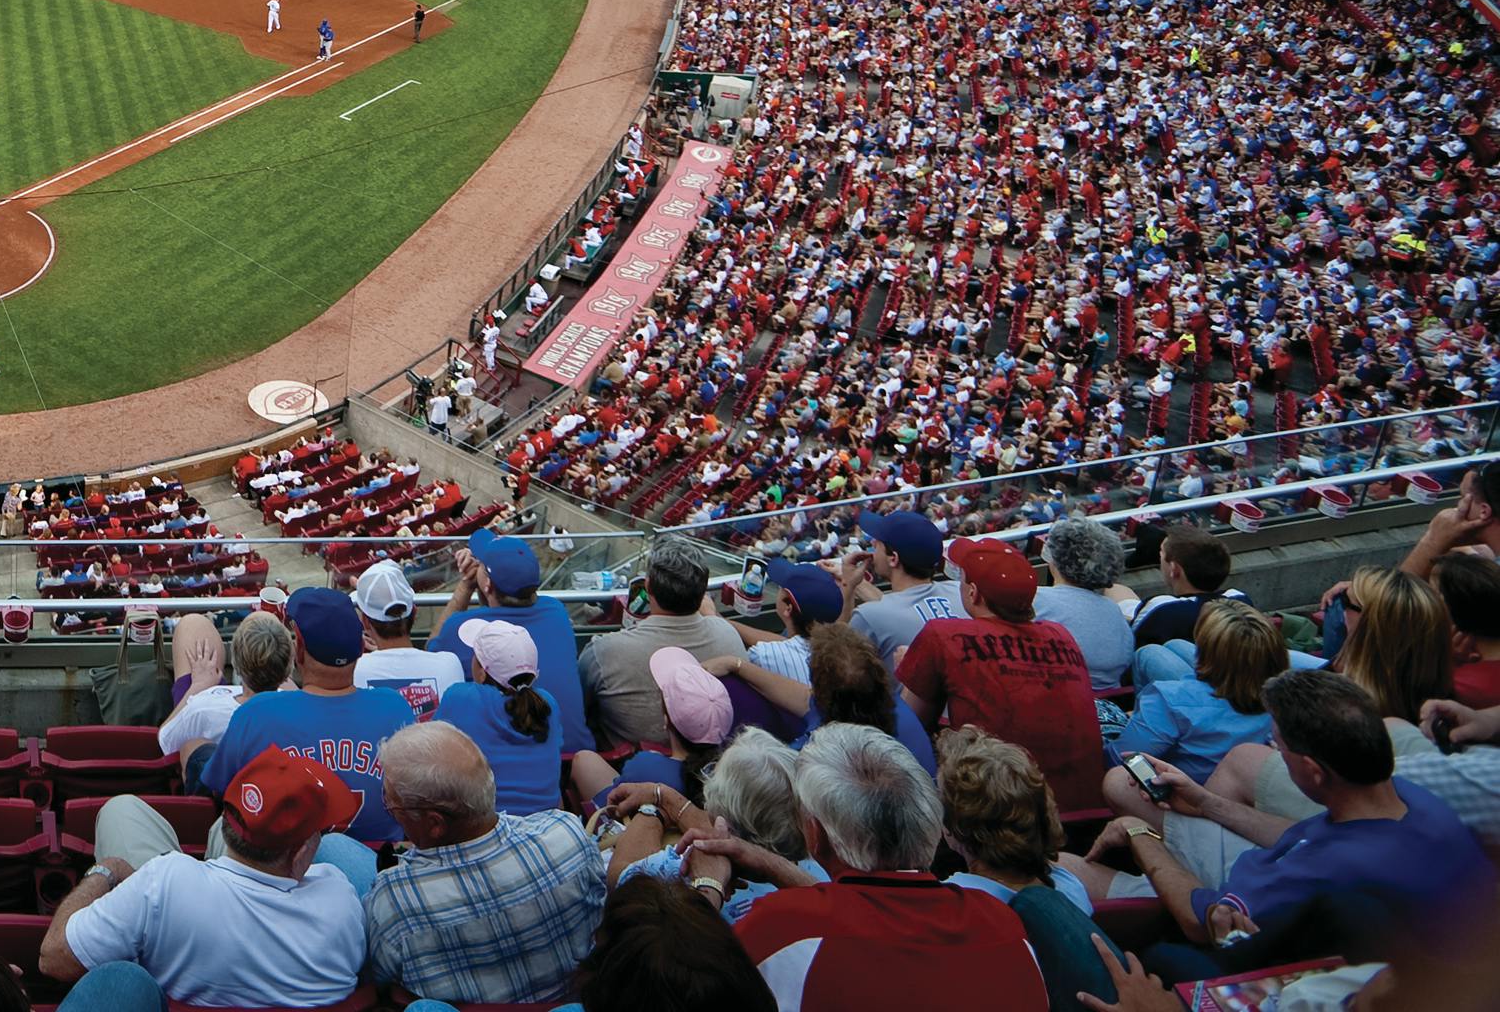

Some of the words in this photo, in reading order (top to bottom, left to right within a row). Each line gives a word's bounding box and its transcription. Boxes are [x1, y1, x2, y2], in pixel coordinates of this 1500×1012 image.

[644, 228, 675, 248] 1975
[620, 261, 654, 280] 1940
[594, 294, 630, 316] 1919
[539, 343, 568, 368] WORLD
[557, 322, 587, 346] SERIES
[556, 326, 611, 379] CHAMPIONS
[914, 597, 958, 624] LEE
[954, 633, 1086, 668] Afflictio
[410, 686, 430, 695] FIELD
